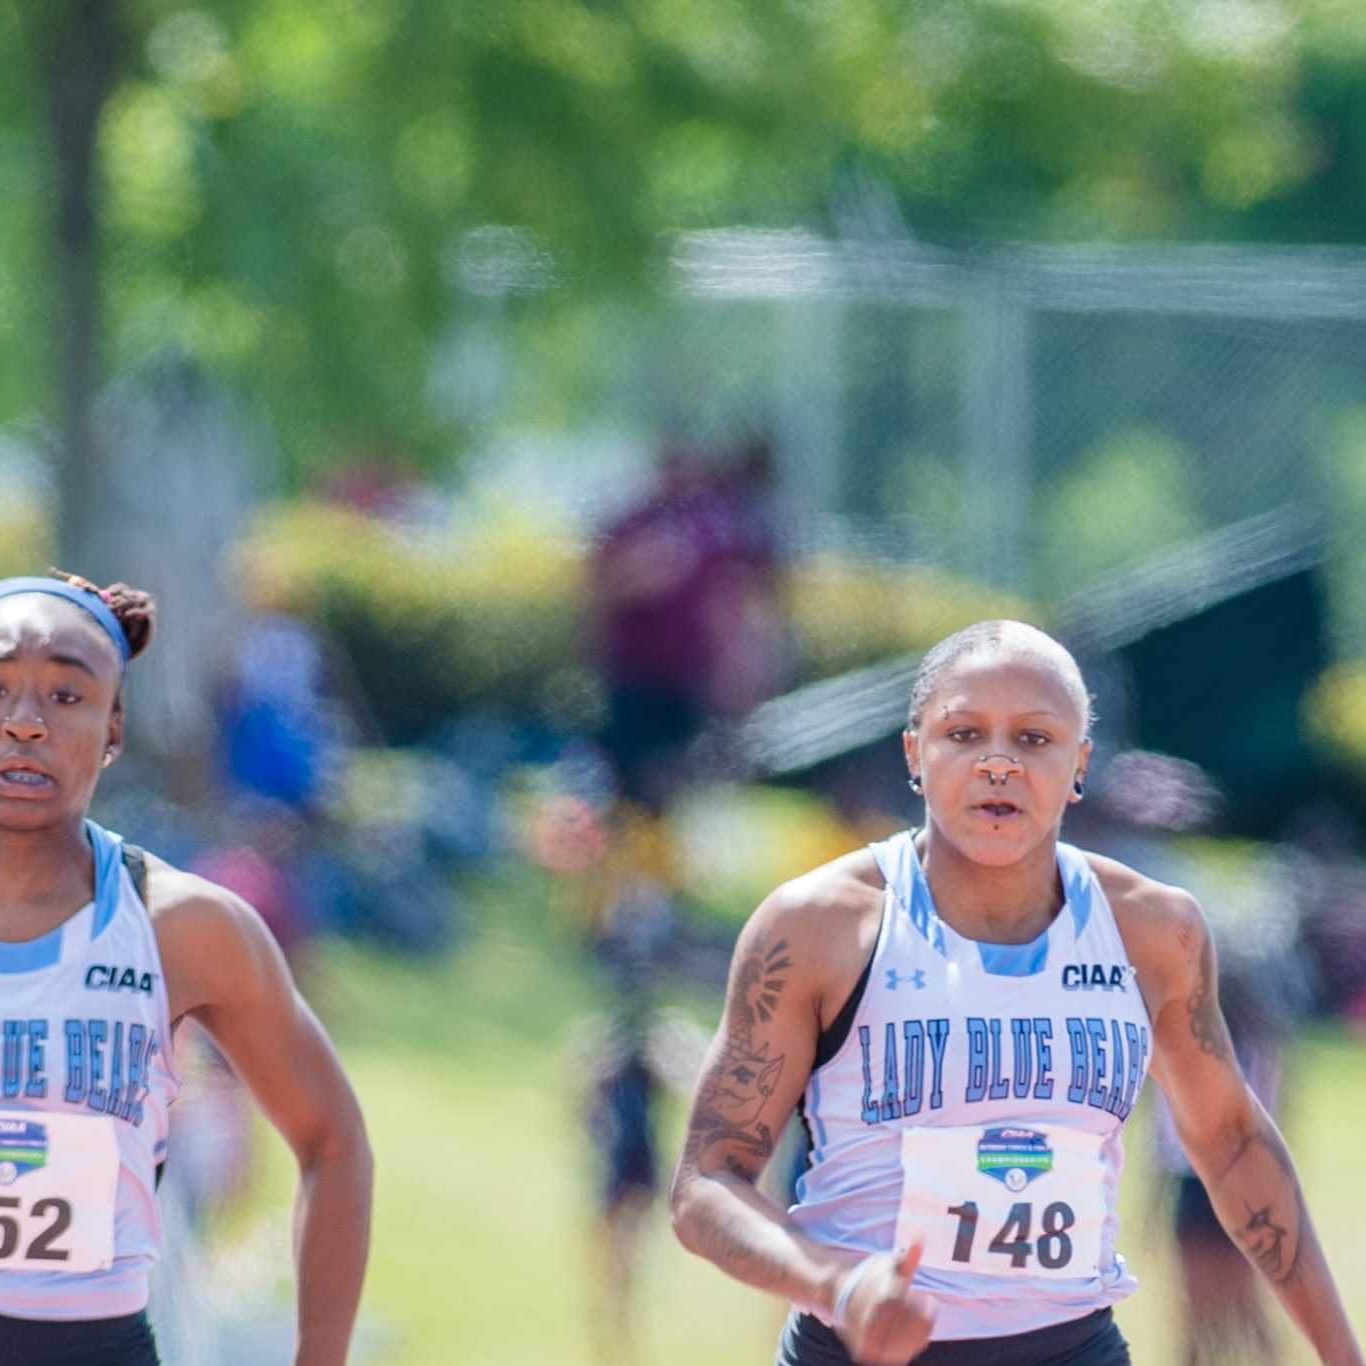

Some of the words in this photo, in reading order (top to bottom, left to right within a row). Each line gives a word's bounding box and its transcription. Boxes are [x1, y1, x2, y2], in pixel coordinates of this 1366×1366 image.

[84, 965, 152, 998] CIAA
[1061, 964, 1127, 994] CIAA
[858, 1018, 949, 1126] LADY
[965, 1017, 1054, 1102] BLUE
[947, 1200, 1075, 1270] 148
